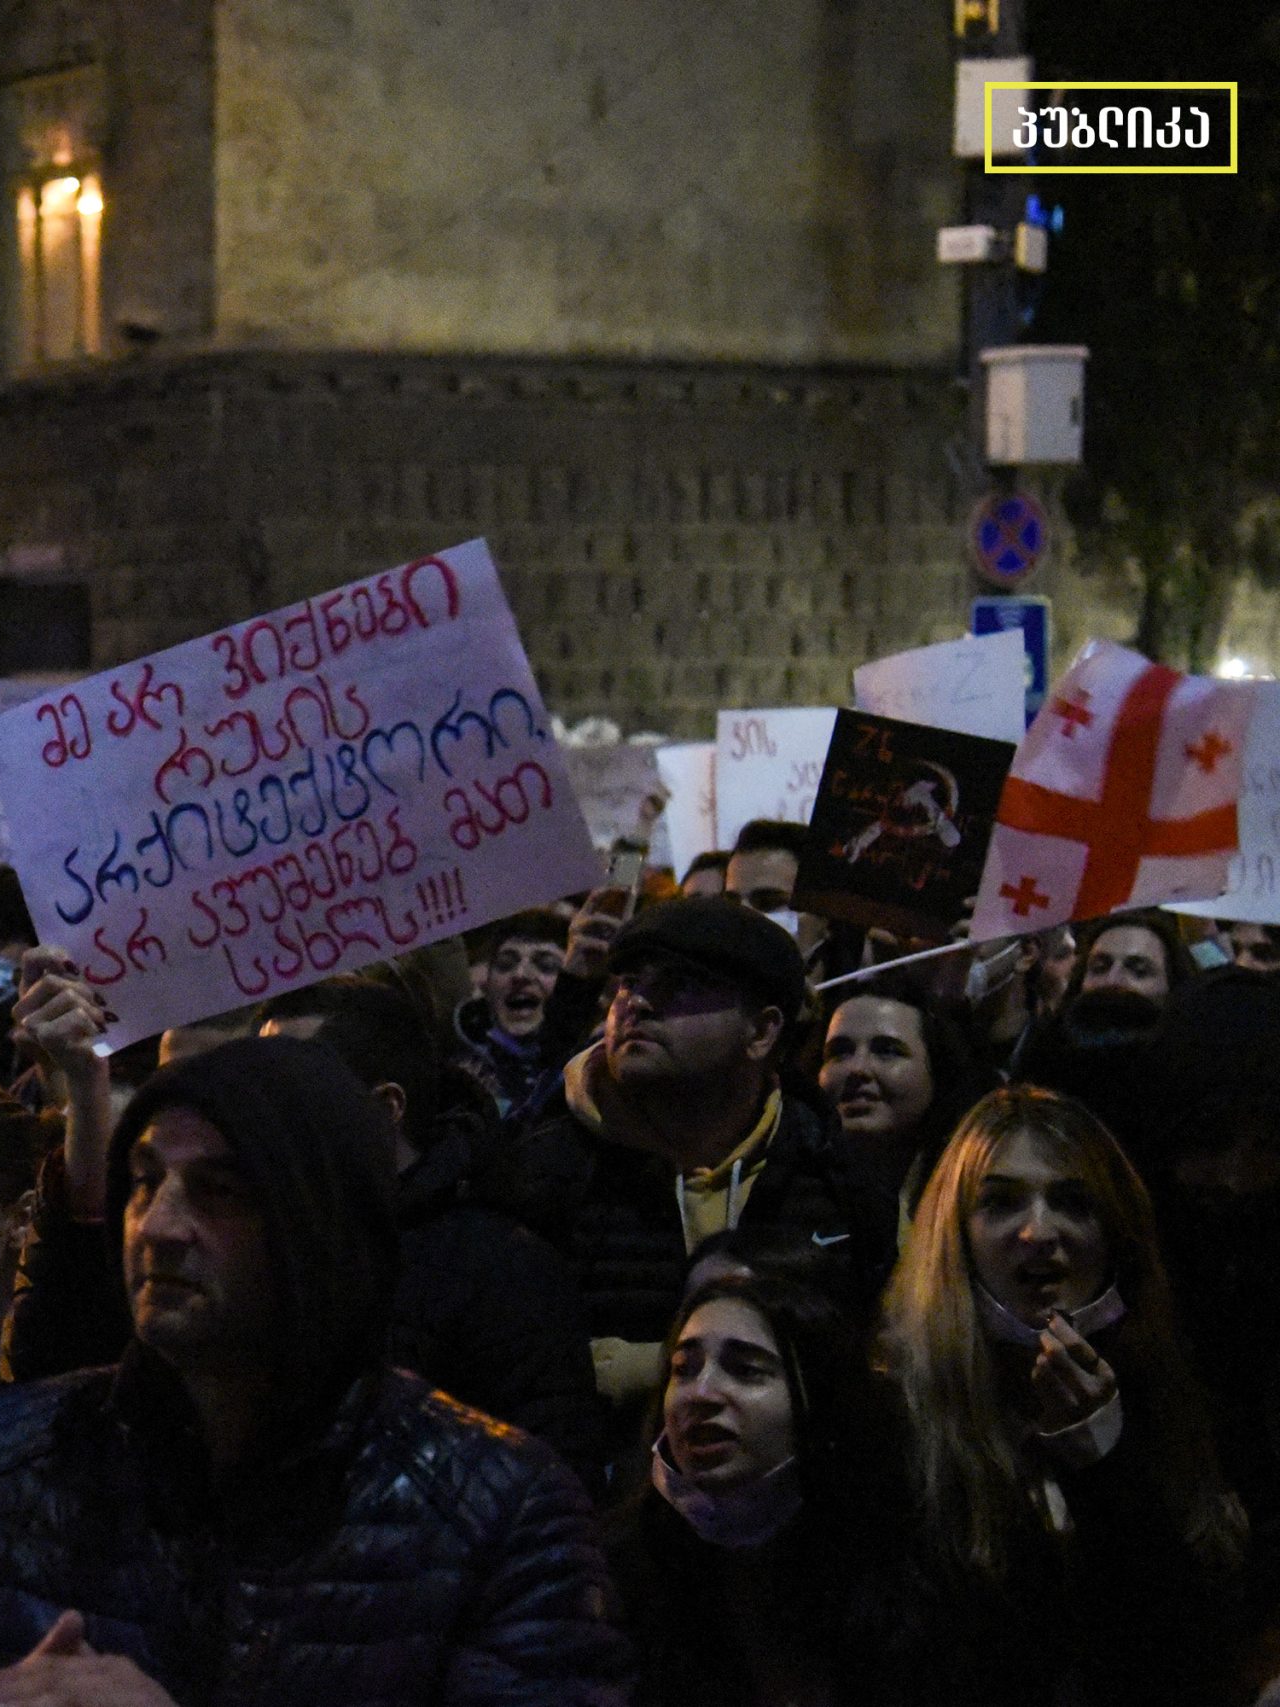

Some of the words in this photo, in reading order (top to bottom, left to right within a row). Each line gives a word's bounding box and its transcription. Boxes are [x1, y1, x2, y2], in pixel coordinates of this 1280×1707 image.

[36, 692, 92, 768] მე
[106, 662, 184, 738] არ
[211, 554, 460, 700] ვიქნები
[154, 673, 370, 805] რუსის
[83, 906, 167, 986] არ
[188, 805, 417, 948] ავუშენებ
[443, 760, 553, 851] მათ
